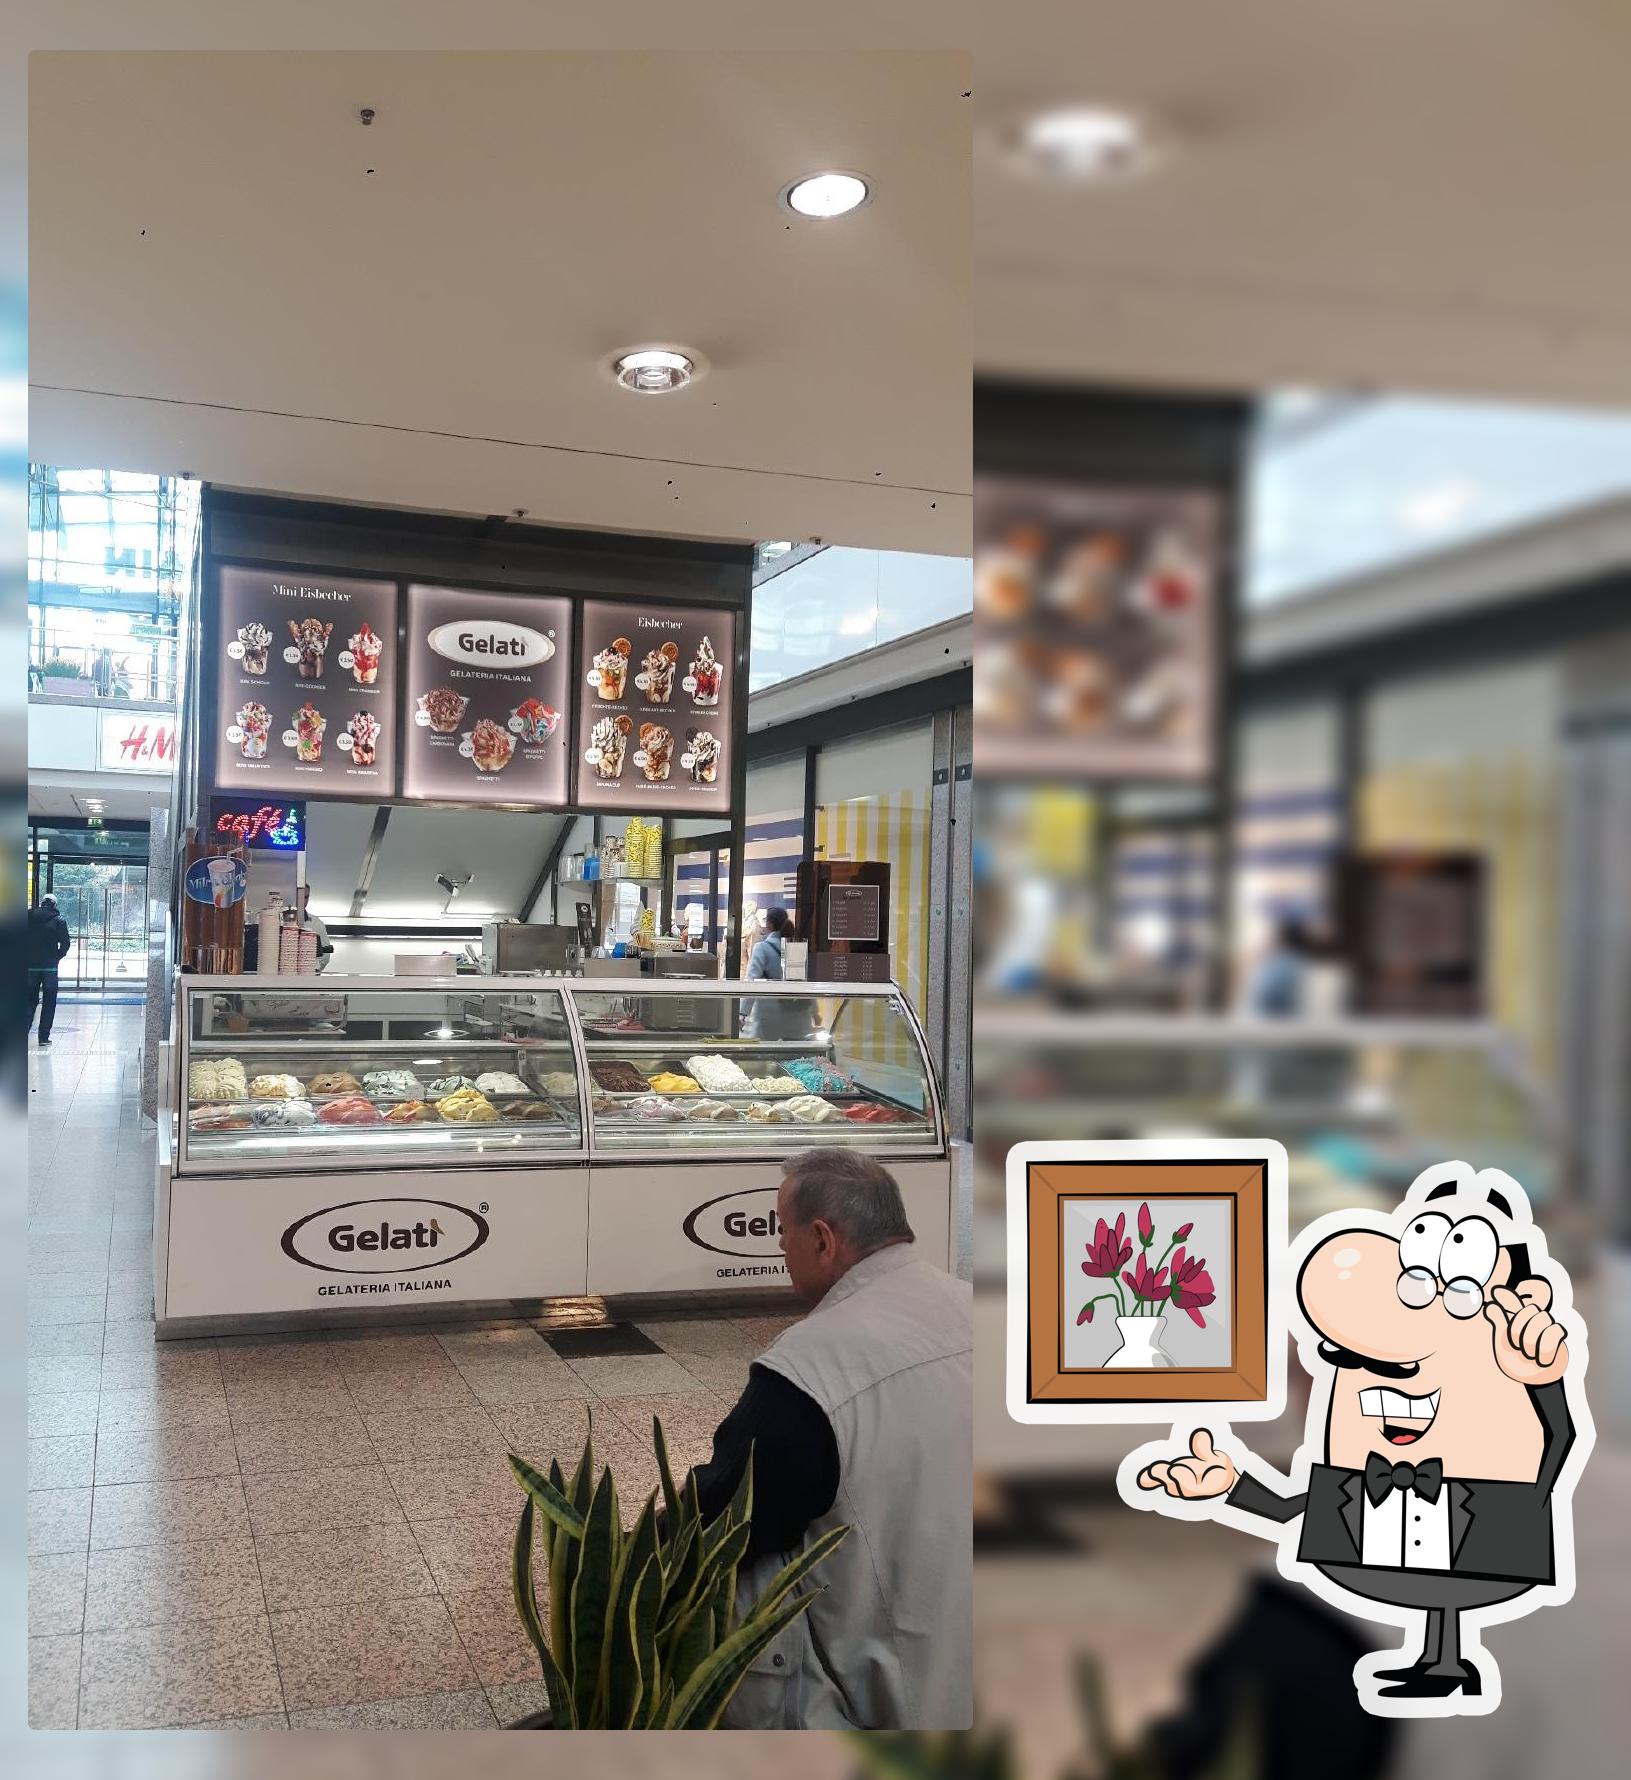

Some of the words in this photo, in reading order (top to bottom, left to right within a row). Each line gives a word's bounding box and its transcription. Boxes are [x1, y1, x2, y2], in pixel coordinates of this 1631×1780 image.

[272, 584, 297, 597] Mini
[300, 586, 352, 601] Eisbecher
[638, 616, 683, 630] Eisbecher
[458, 633, 528, 656] Gelati
[450, 669, 495, 680] GELATERIA
[495, 674, 532, 683] ITALIANA
[120, 725, 175, 761] H&M
[217, 806, 283, 840] café
[327, 1218, 446, 1252] Gelati
[716, 1265, 780, 1278] GELATERIA
[317, 1283, 391, 1297] GELATERIA
[393, 1279, 453, 1293] ITALIANA
